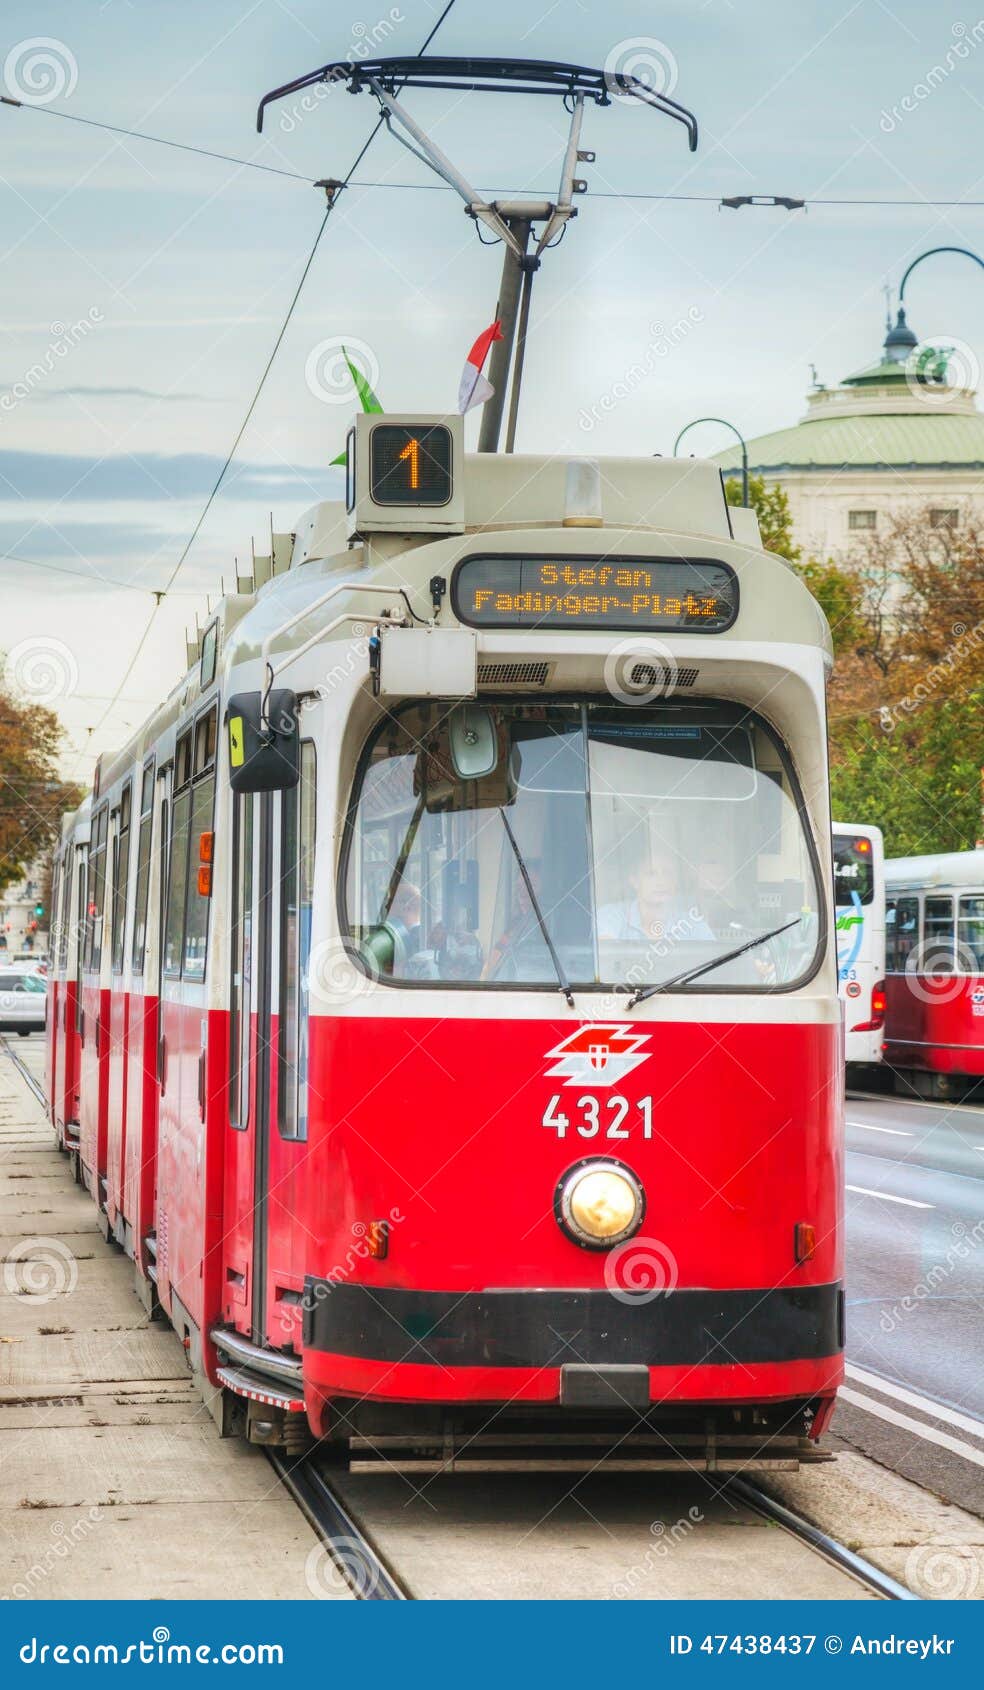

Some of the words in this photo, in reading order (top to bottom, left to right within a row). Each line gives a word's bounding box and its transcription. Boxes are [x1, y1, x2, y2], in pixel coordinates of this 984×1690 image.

[399, 439, 418, 489] 1
[540, 564, 652, 587] Stefan
[475, 589, 717, 616] Fadinger-Platz
[542, 1094, 653, 1139] 4321
